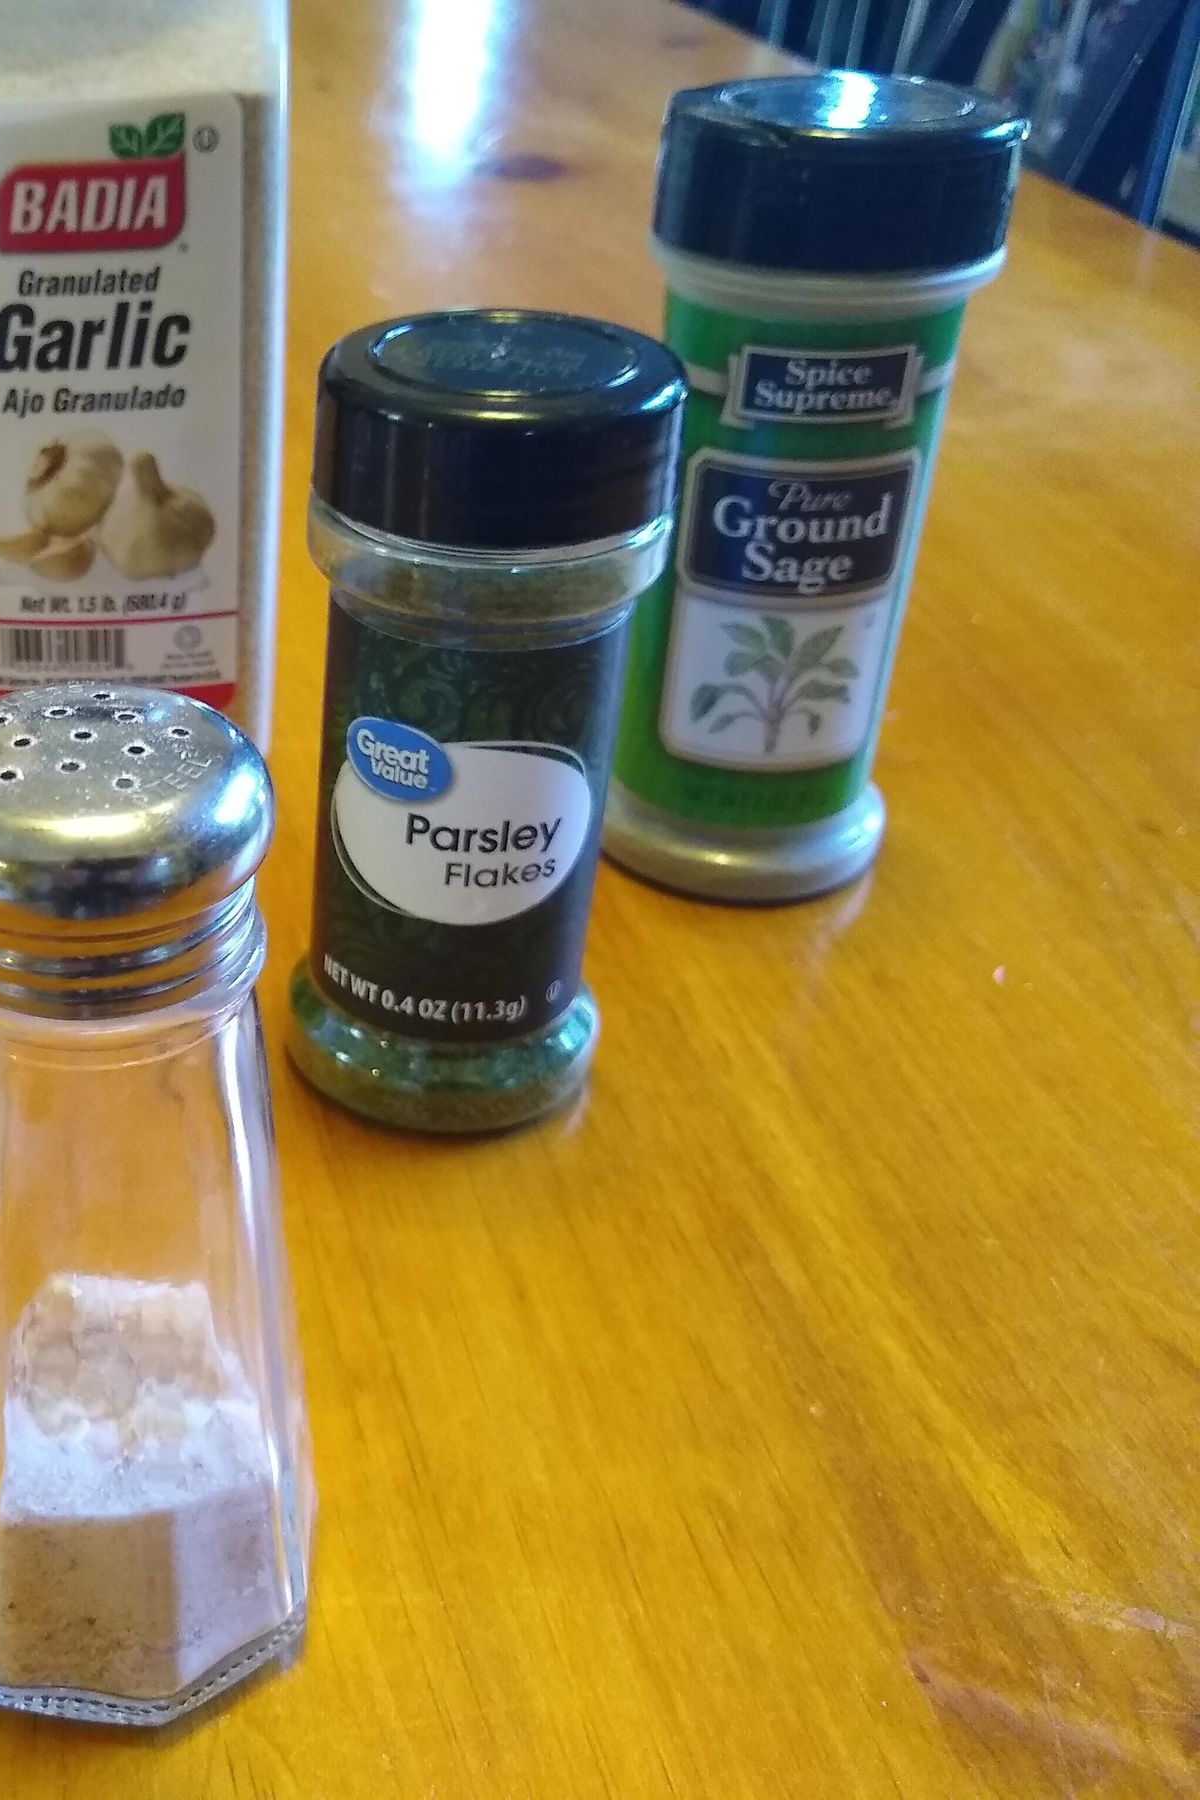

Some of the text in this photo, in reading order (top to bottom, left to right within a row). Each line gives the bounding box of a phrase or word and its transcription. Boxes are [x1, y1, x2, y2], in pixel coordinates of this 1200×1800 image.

[9, 174, 170, 236] BADIA
[17, 266, 163, 297] Granulated
[784, 359, 874, 390] Spice
[1, 383, 187, 419] Ajo Granulado
[754, 378, 894, 415] Supreme
[767, 479, 853, 512] Pure
[712, 491, 894, 544] Ground
[741, 541, 854, 595] Sage
[356, 728, 430, 774] Great
[130, 757, 213, 805] TEEL
[370, 756, 428, 790] Value
[405, 813, 562, 853] Parsley
[443, 856, 557, 889] Flakes
[323, 953, 529, 1025] NET WT 0.4 OZ (11.3g)
